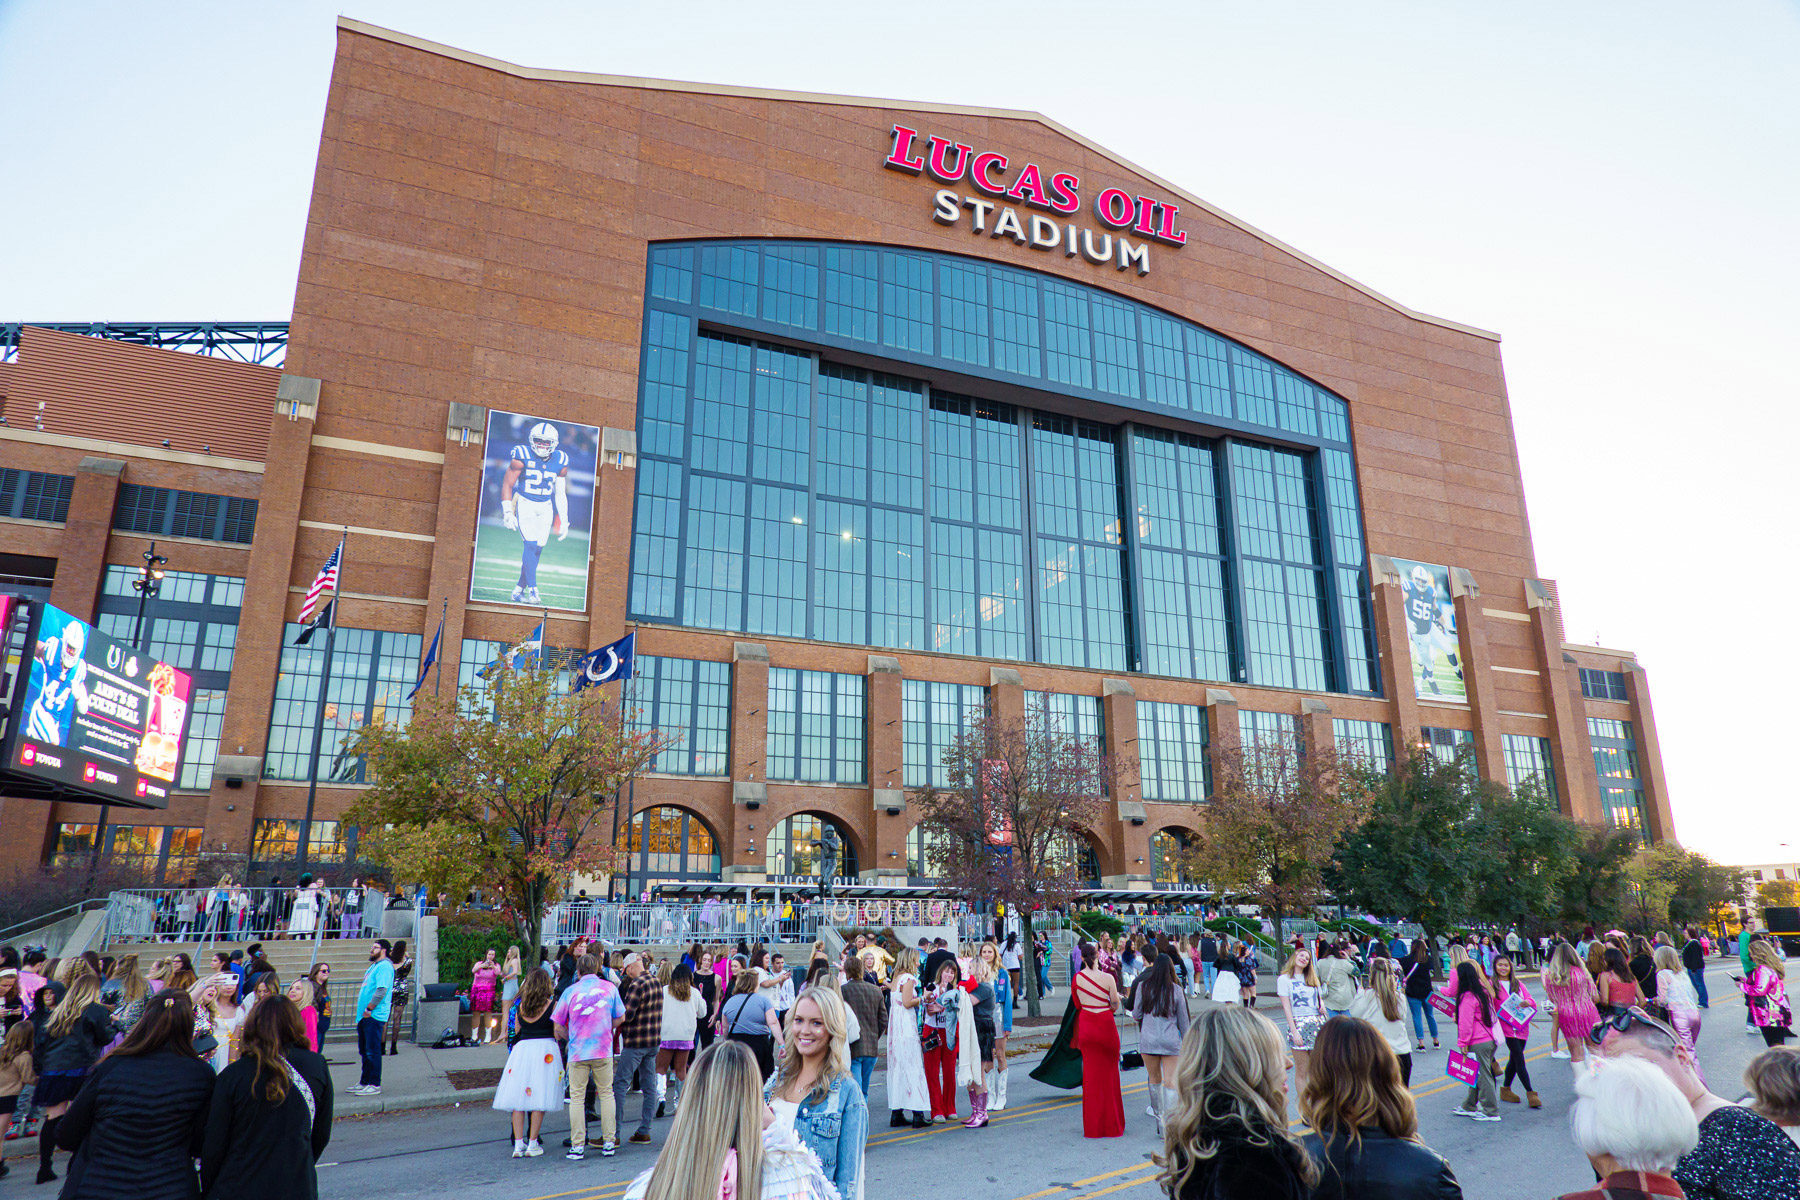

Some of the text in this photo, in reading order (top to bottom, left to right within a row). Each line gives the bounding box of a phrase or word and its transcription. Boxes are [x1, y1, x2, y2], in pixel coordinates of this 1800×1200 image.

[884, 124, 1187, 248] LUCAS OIL
[932, 189, 1150, 277] STADIUM
[524, 468, 557, 496] 23
[1412, 598, 1432, 621] 56
[88, 693, 118, 716] COLTS
[35, 752, 61, 769] TOYOTA
[95, 769, 118, 784] TOYOTA
